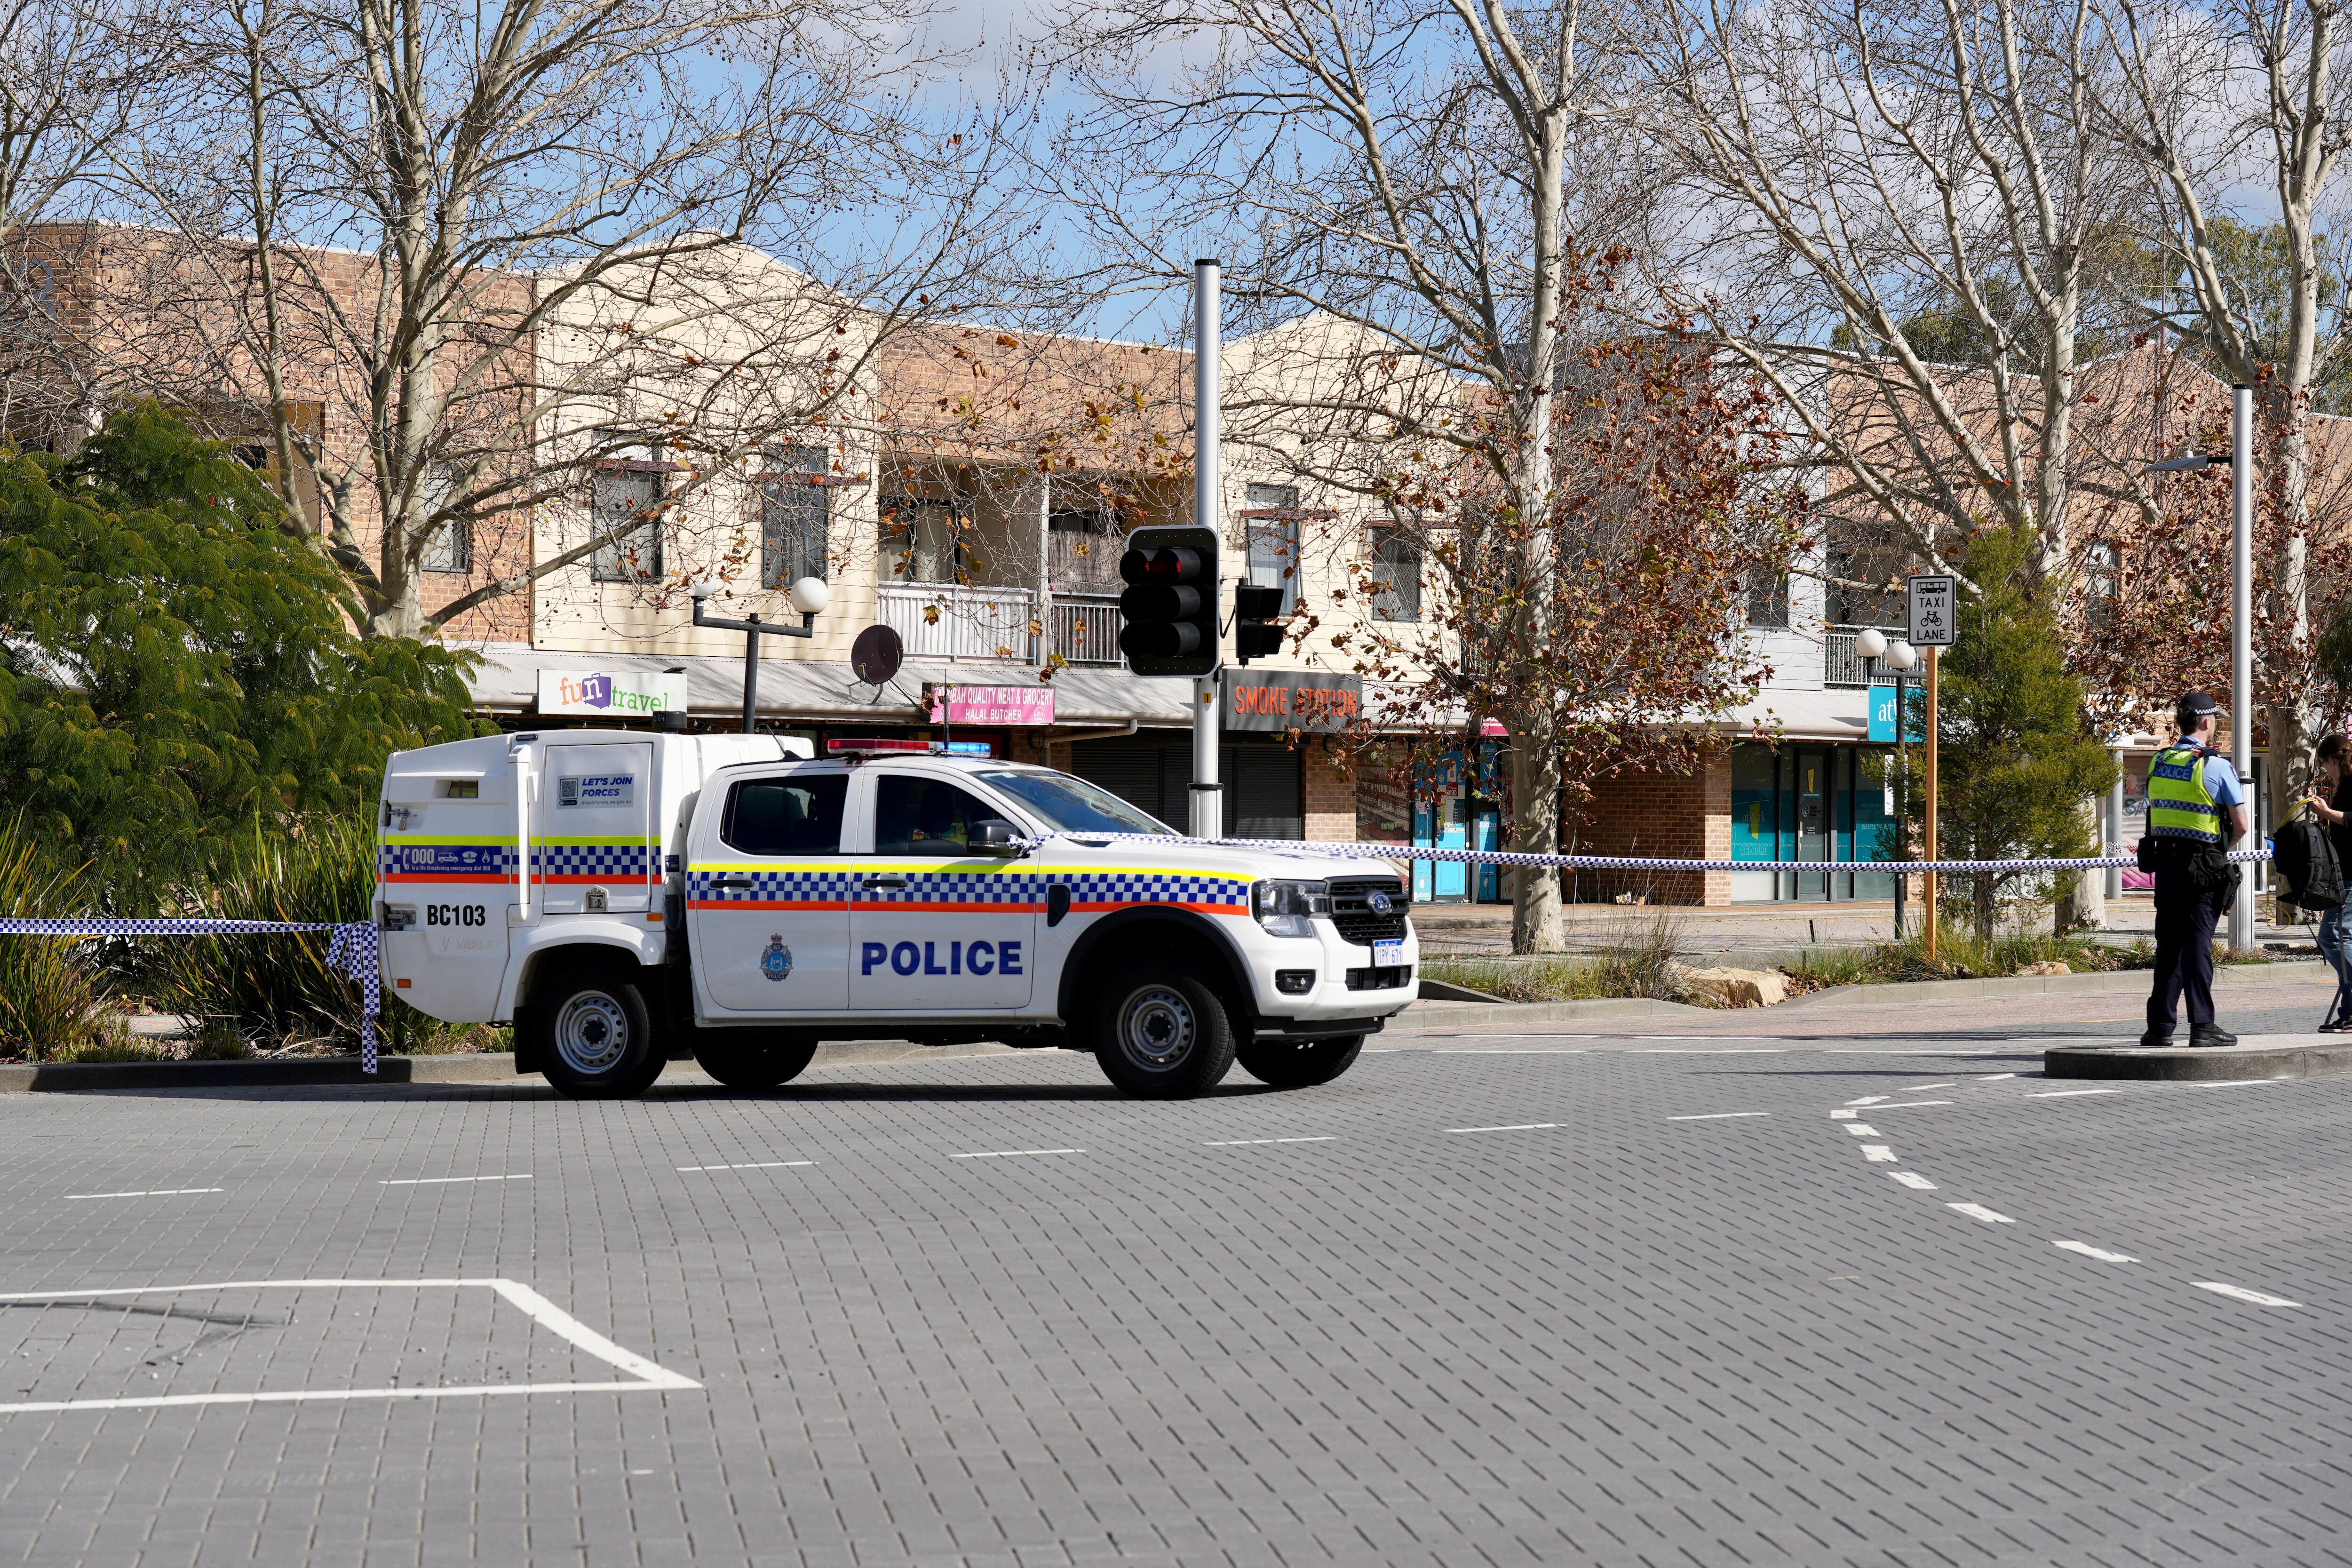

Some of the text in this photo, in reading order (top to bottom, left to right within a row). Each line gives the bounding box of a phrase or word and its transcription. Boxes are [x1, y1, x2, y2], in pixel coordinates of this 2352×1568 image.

[1919, 597, 1944, 608] TAXI
[1917, 629, 1946, 640] LANE
[560, 677, 668, 712] fun travel
[968, 688, 996, 705] QUALITY
[997, 688, 1015, 704] MEAT
[1016, 690, 1020, 704] &
[1022, 688, 1054, 705] GROCERY
[1235, 685, 1357, 717] SMOKE STATION
[965, 708, 1022, 720] HALAL BUTCHER
[582, 778, 609, 786] LET'S
[412, 848, 435, 864] 000
[1740, 846, 1767, 856] WELCOME
[427, 905, 485, 927] BC103
[330, 936, 341, 963] POLICE
[862, 941, 1023, 976] POLICE
